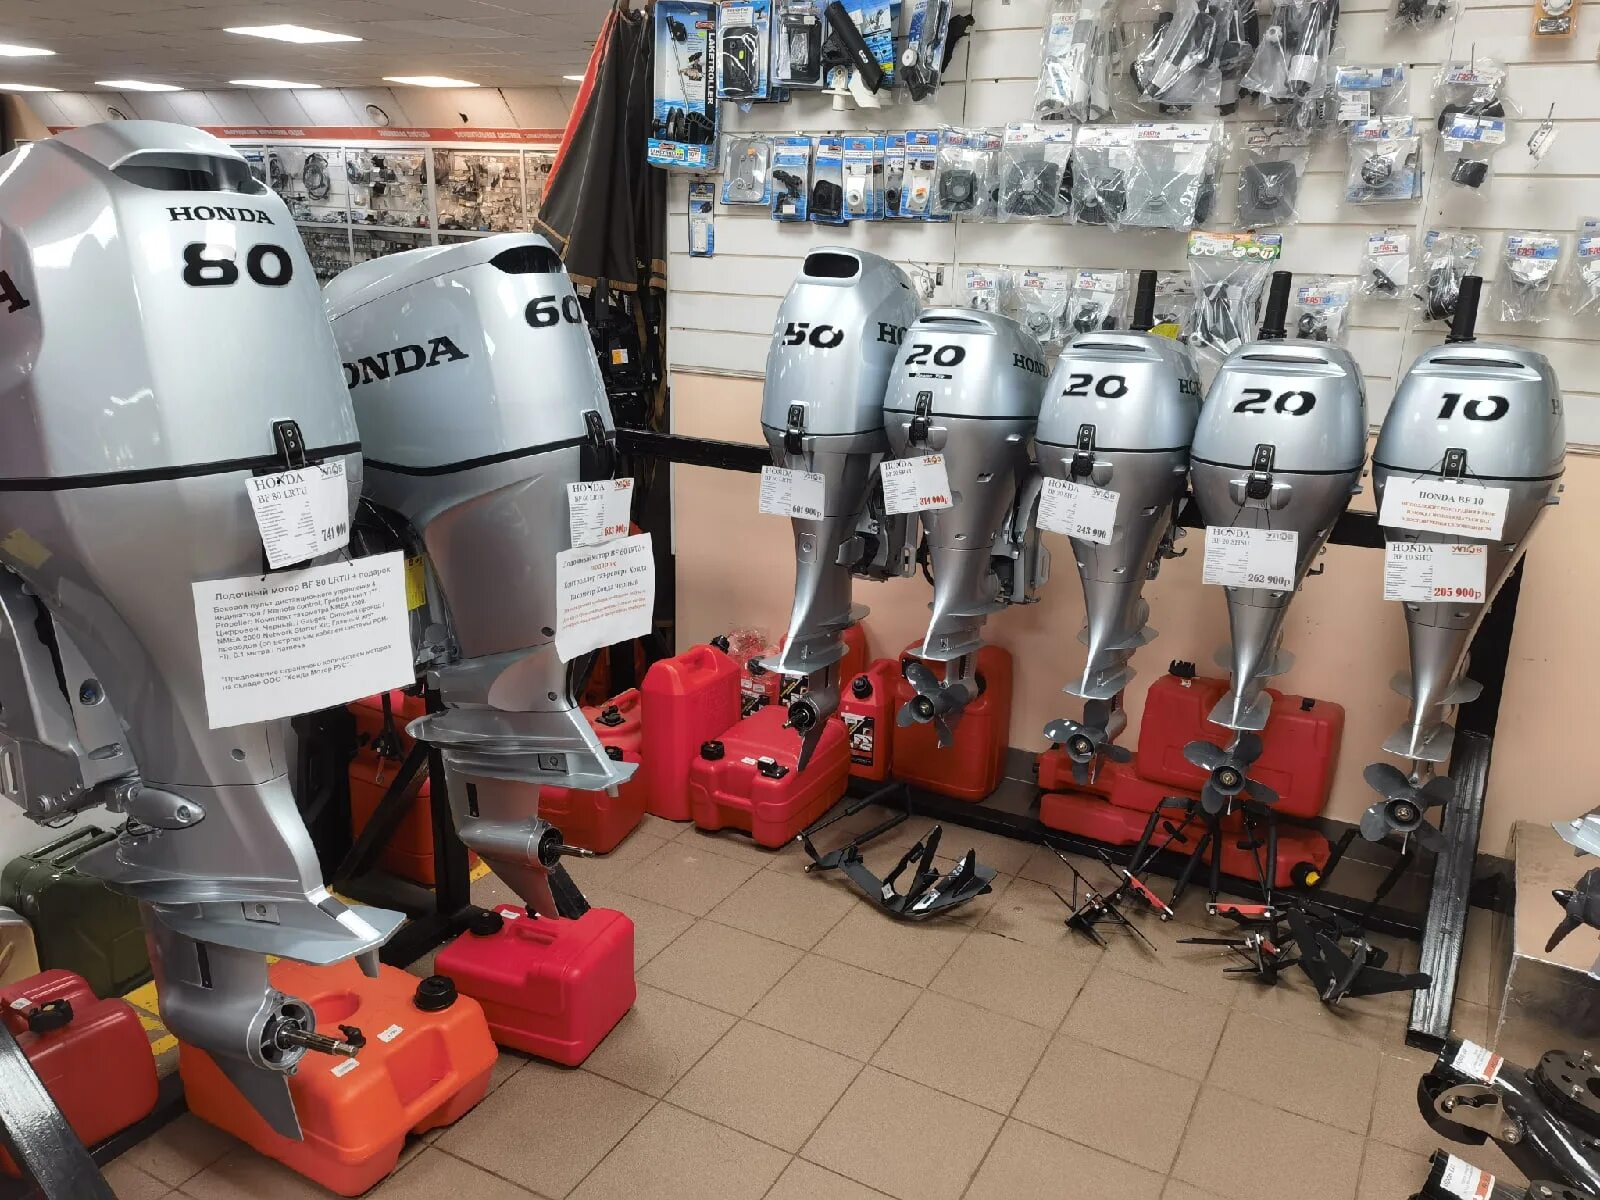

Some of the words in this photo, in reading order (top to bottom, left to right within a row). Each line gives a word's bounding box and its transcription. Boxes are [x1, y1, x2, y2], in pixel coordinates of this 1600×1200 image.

[708, 32, 716, 105] LAKETROLLER
[166, 206, 275, 225] HONDA
[182, 242, 293, 288] 80
[525, 295, 583, 328] 60
[782, 322, 844, 349] 50
[905, 344, 966, 367] 20
[1062, 374, 1128, 398] 20
[1234, 388, 1317, 417] 20
[1436, 392, 1510, 422] 10
[884, 460, 913, 470] HONDA
[254, 472, 304, 491] HONDA
[573, 483, 605, 492] HONDA
[1048, 479, 1079, 492] HONDA
[1419, 491, 1455, 503] HONDA
[1458, 496, 1471, 504] BF
[1474, 497, 1484, 506] 10
[321, 527, 335, 541] 741
[1213, 528, 1250, 538] HONDA
[1392, 544, 1434, 553] HONDA
[216, 588, 268, 600] Лодочный
[271, 584, 300, 594] мотор
[1434, 587, 1452, 597] 205
[1455, 587, 1481, 600] 900р
